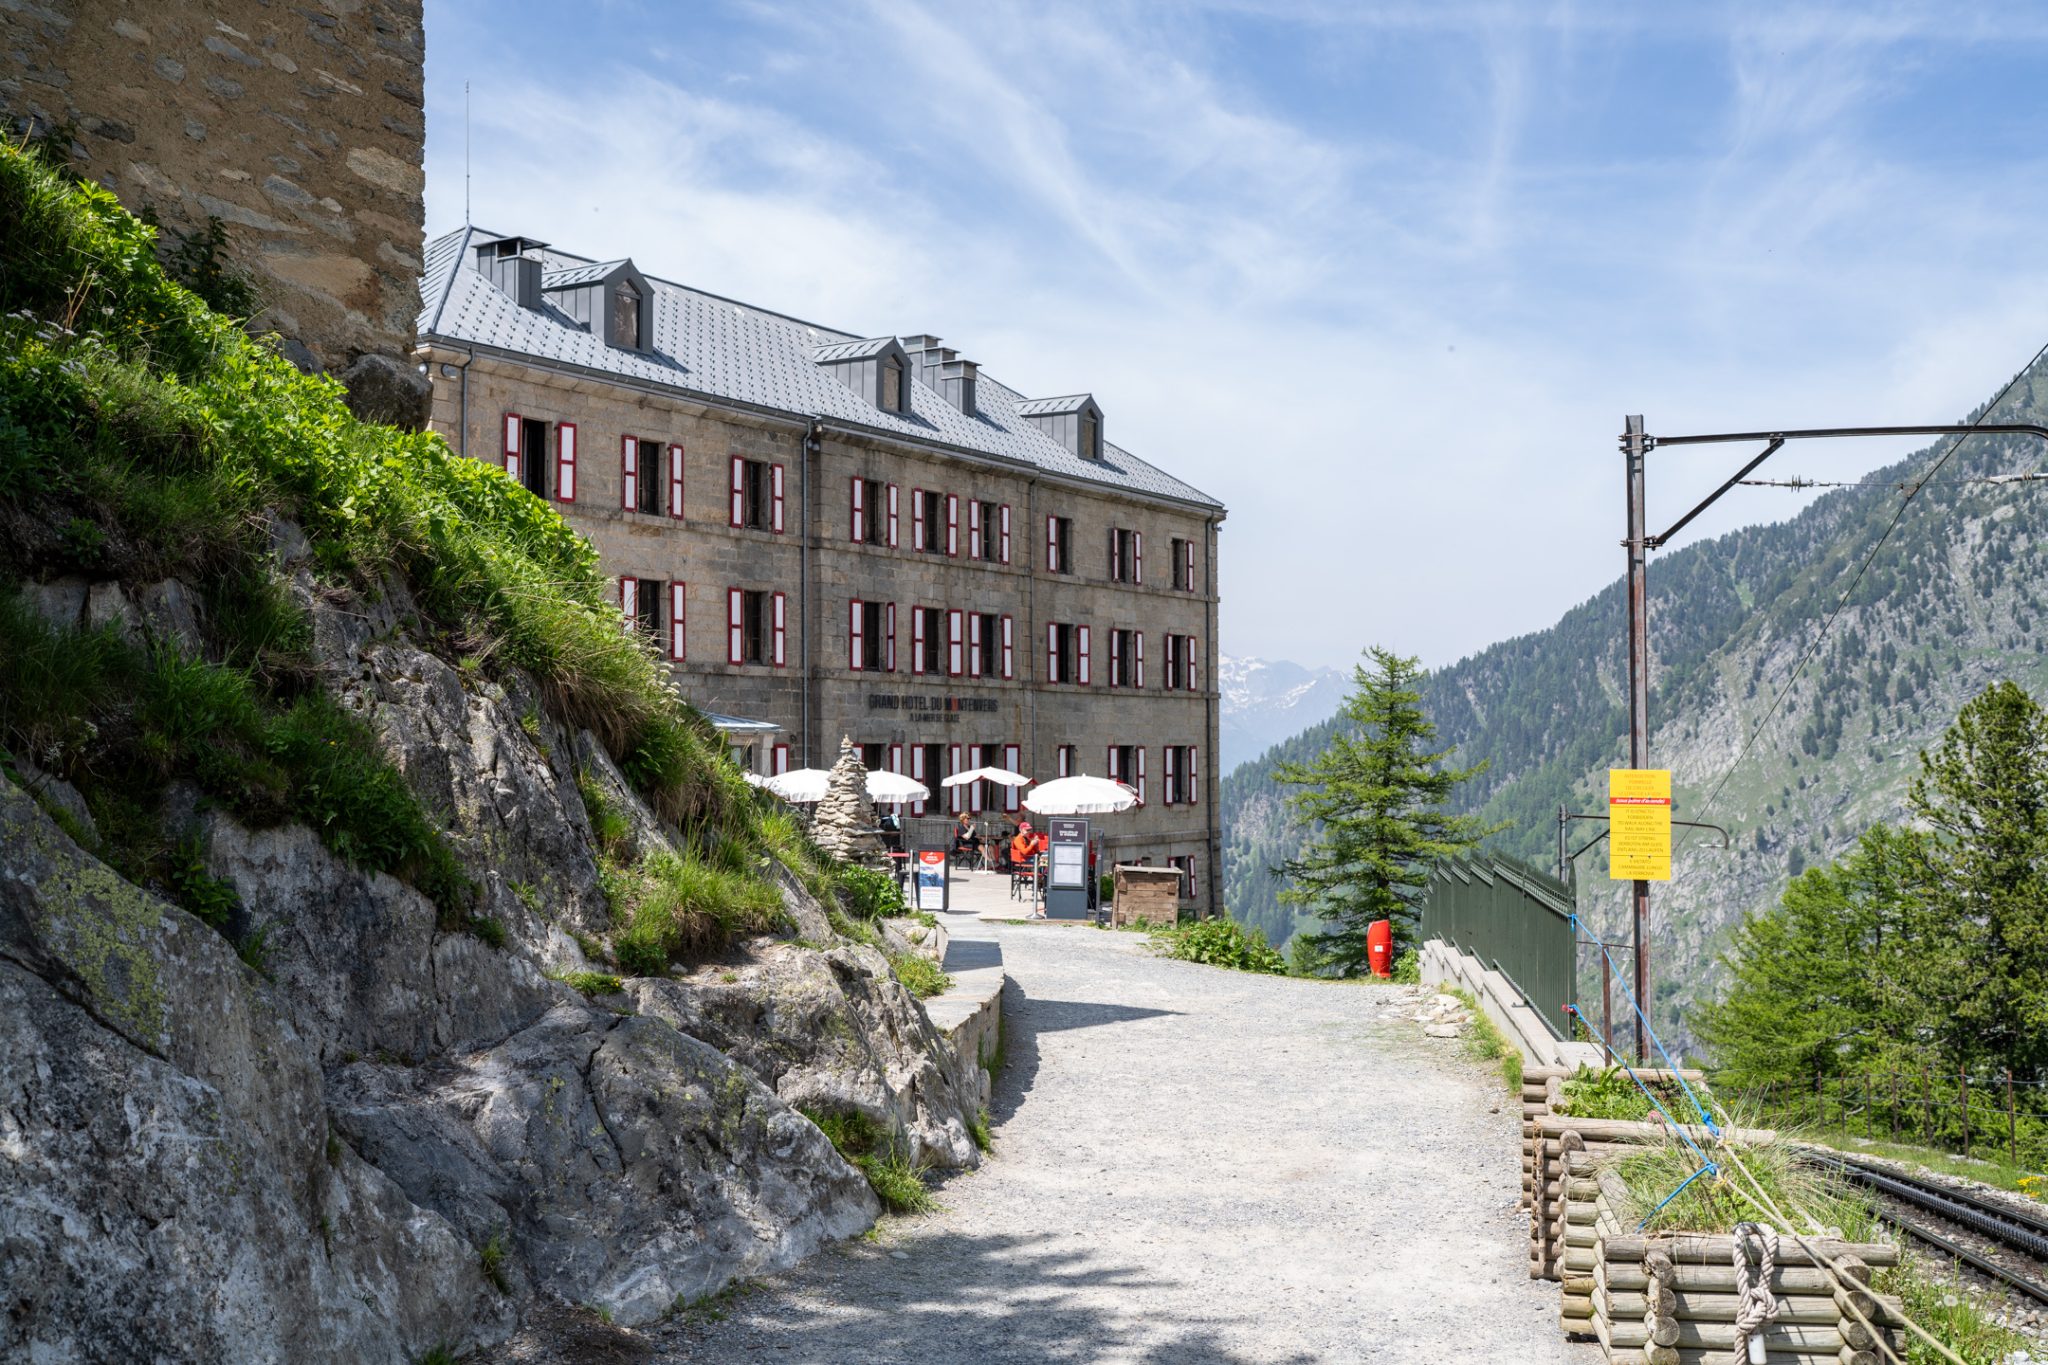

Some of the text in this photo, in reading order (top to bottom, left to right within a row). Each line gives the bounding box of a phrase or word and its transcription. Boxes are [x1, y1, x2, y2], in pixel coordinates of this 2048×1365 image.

[869, 694, 899, 709] GRAND
[901, 696, 929, 710] HOTEL
[931, 697, 942, 710] DU
